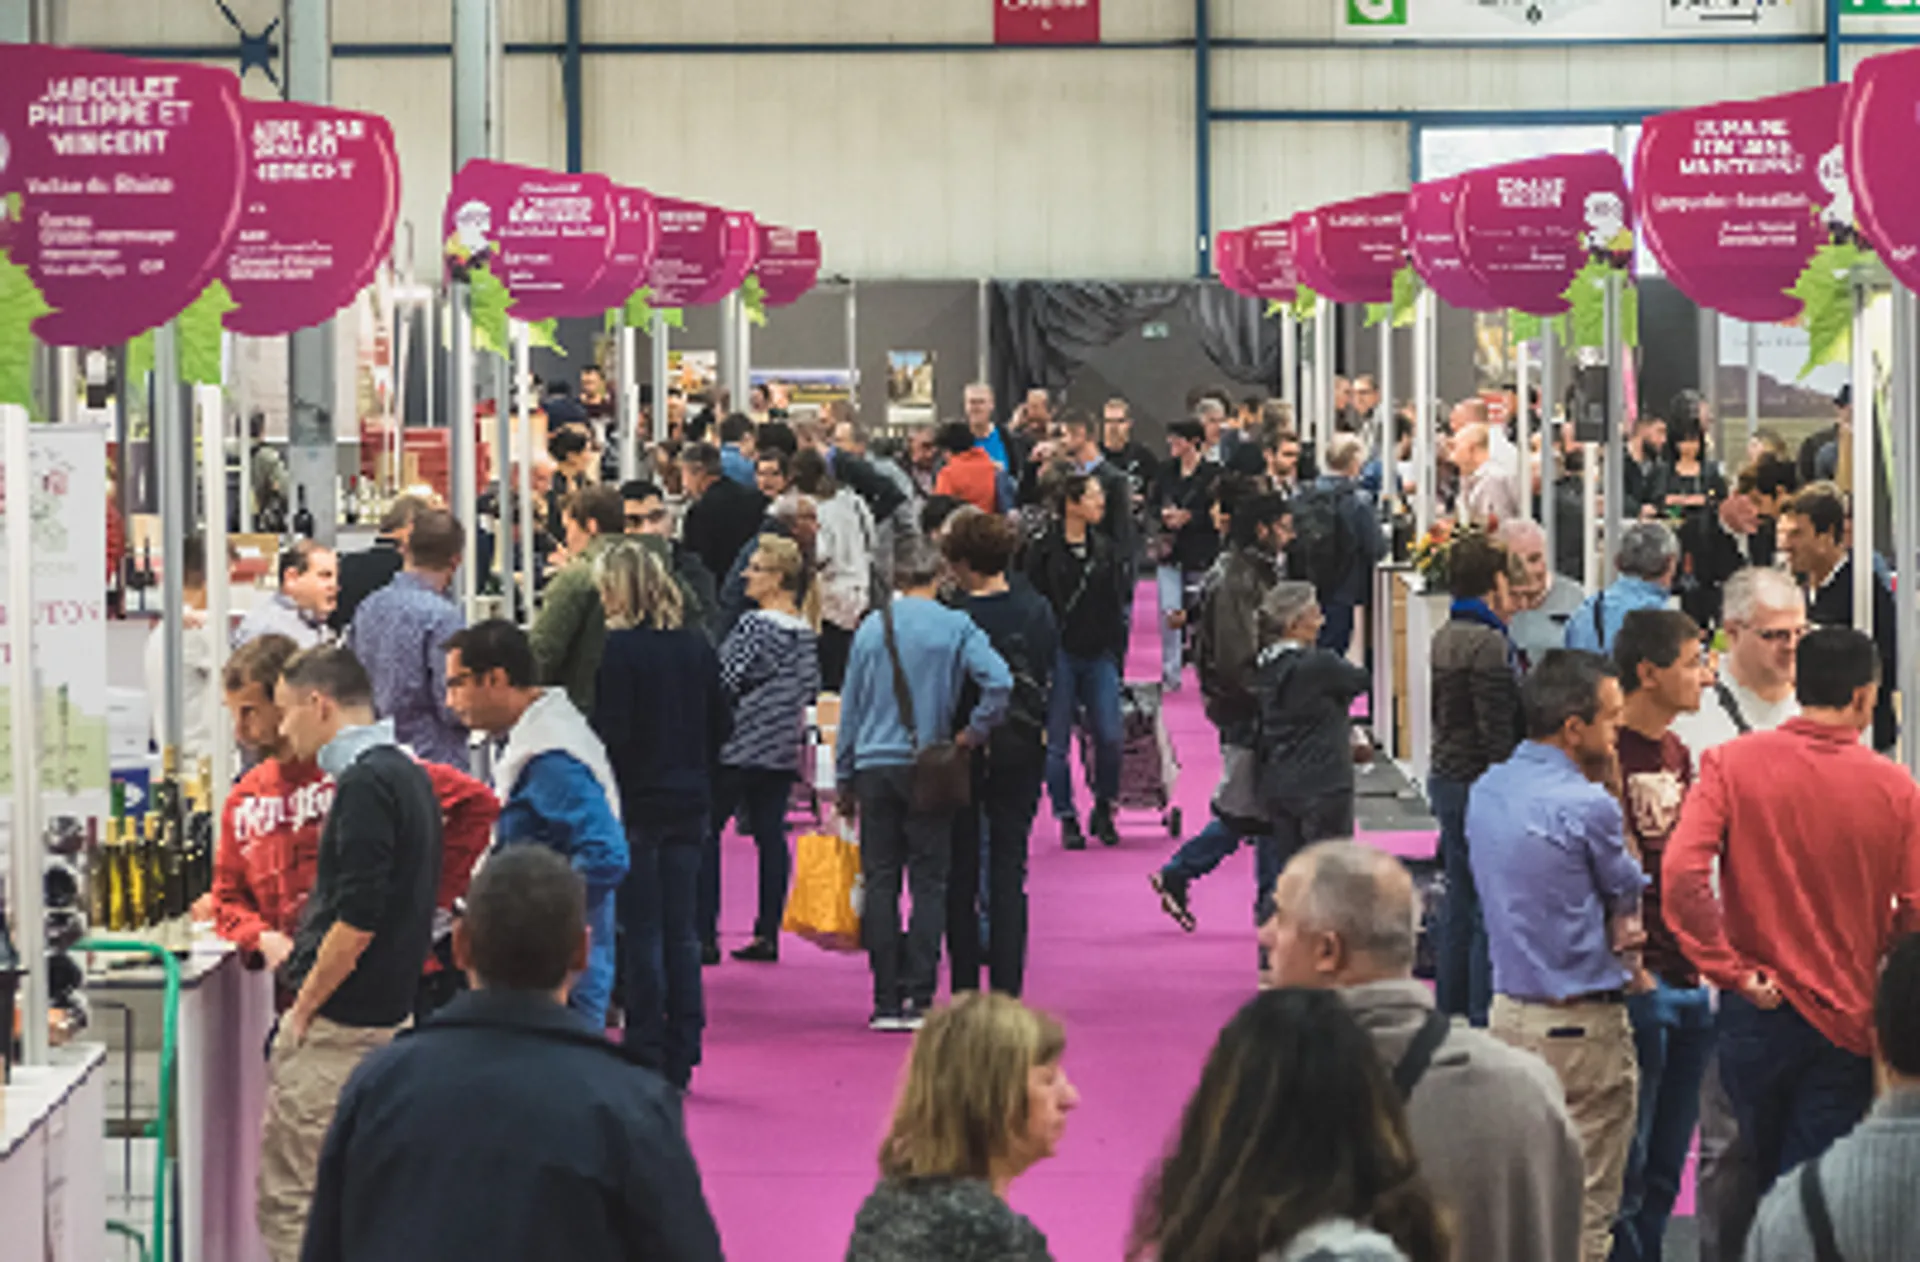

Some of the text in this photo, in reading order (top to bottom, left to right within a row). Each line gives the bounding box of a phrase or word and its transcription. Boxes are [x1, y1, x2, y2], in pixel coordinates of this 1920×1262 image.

[39, 76, 180, 102] JABOULET
[28, 101, 192, 127] PHILIPPE ET
[48, 129, 169, 155] VINCENT
